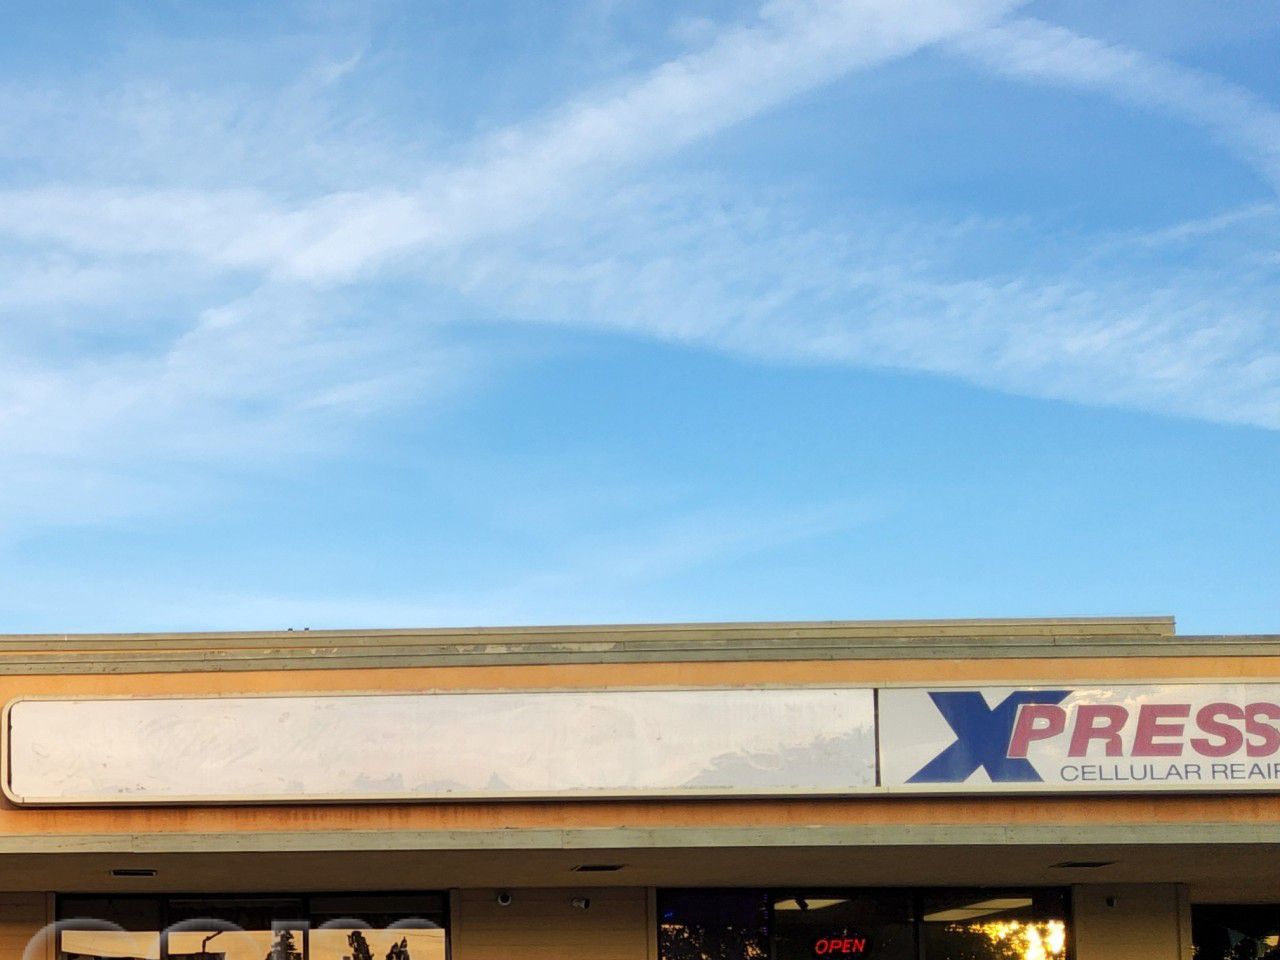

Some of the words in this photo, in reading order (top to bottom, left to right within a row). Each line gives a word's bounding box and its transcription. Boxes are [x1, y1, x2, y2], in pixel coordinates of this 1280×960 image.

[904, 690, 1280, 784] XPRESS
[1060, 763, 1201, 782] CELLULAR
[815, 938, 866, 955] OPEN
